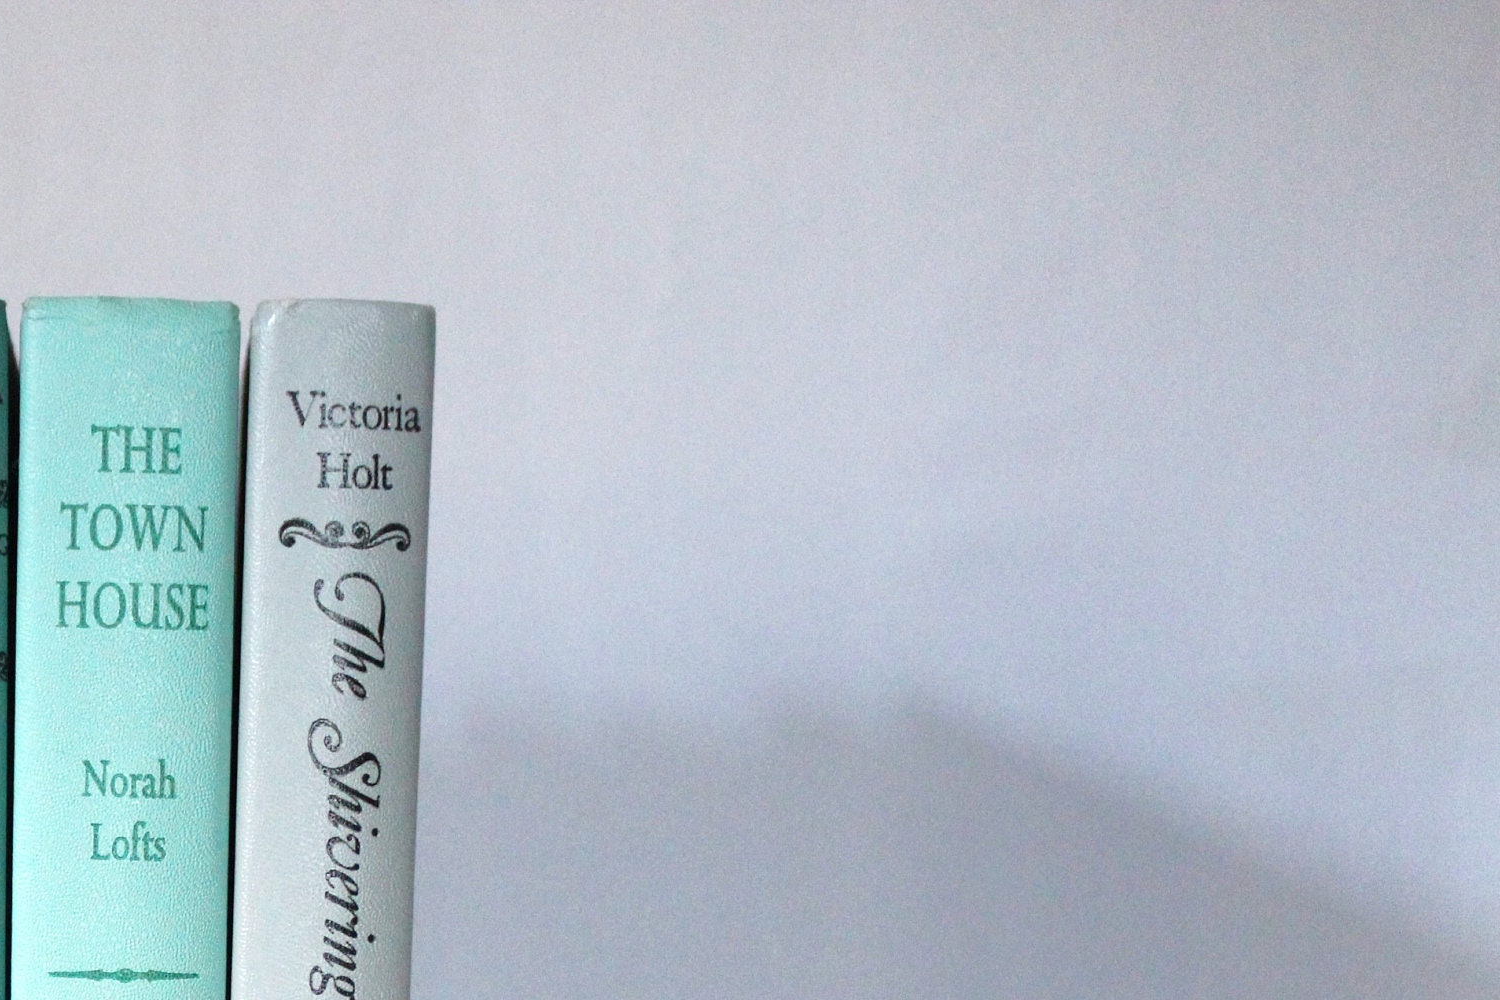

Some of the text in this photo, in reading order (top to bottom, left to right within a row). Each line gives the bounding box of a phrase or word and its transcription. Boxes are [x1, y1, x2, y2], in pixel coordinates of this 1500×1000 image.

[286, 389, 421, 435] Victoria
[91, 424, 183, 474] THE
[316, 450, 393, 491] Holt
[60, 501, 208, 552] TOWN
[56, 580, 210, 631] HOUSE
[313, 570, 386, 700] The
[82, 758, 177, 800] Norah
[90, 821, 167, 862] Lofts
